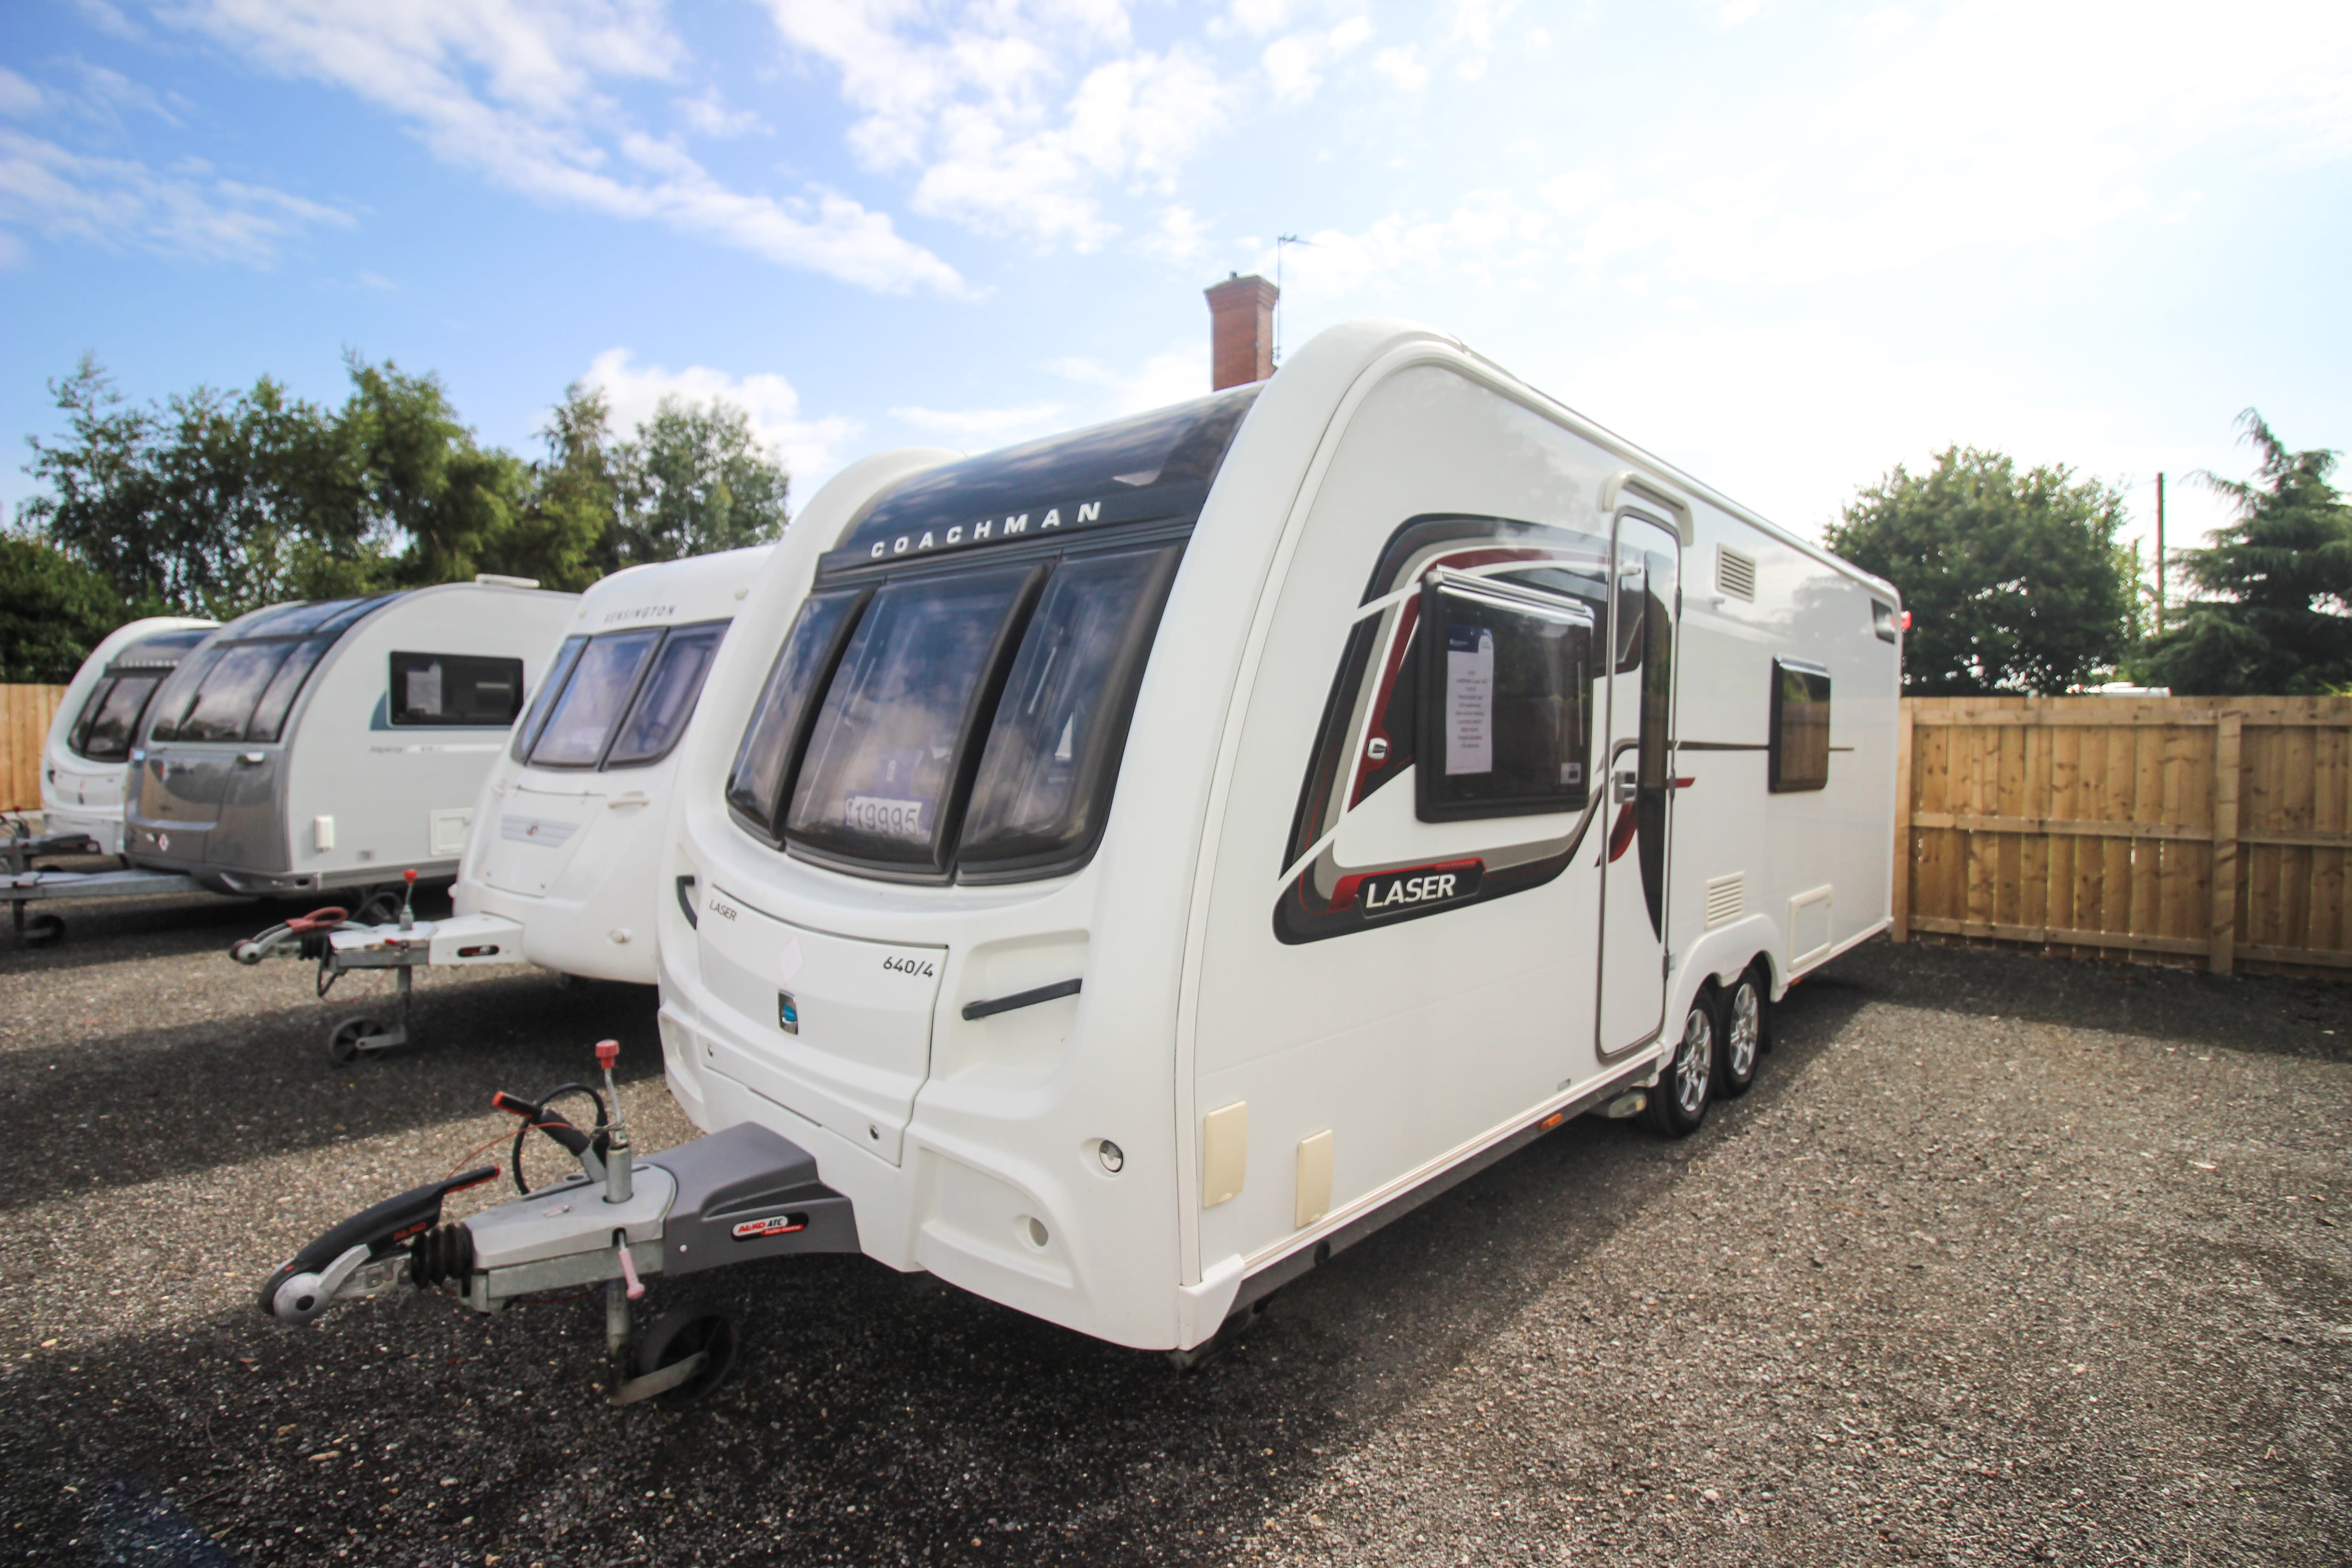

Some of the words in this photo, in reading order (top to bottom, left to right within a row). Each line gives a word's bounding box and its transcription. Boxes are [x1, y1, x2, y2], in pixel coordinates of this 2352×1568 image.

[871, 501, 1102, 558] COACHMAN
[1366, 874, 1456, 908] LASER
[709, 899, 737, 921] LASER
[883, 956, 933, 977] 640/4
[767, 1218, 783, 1227] ATC
